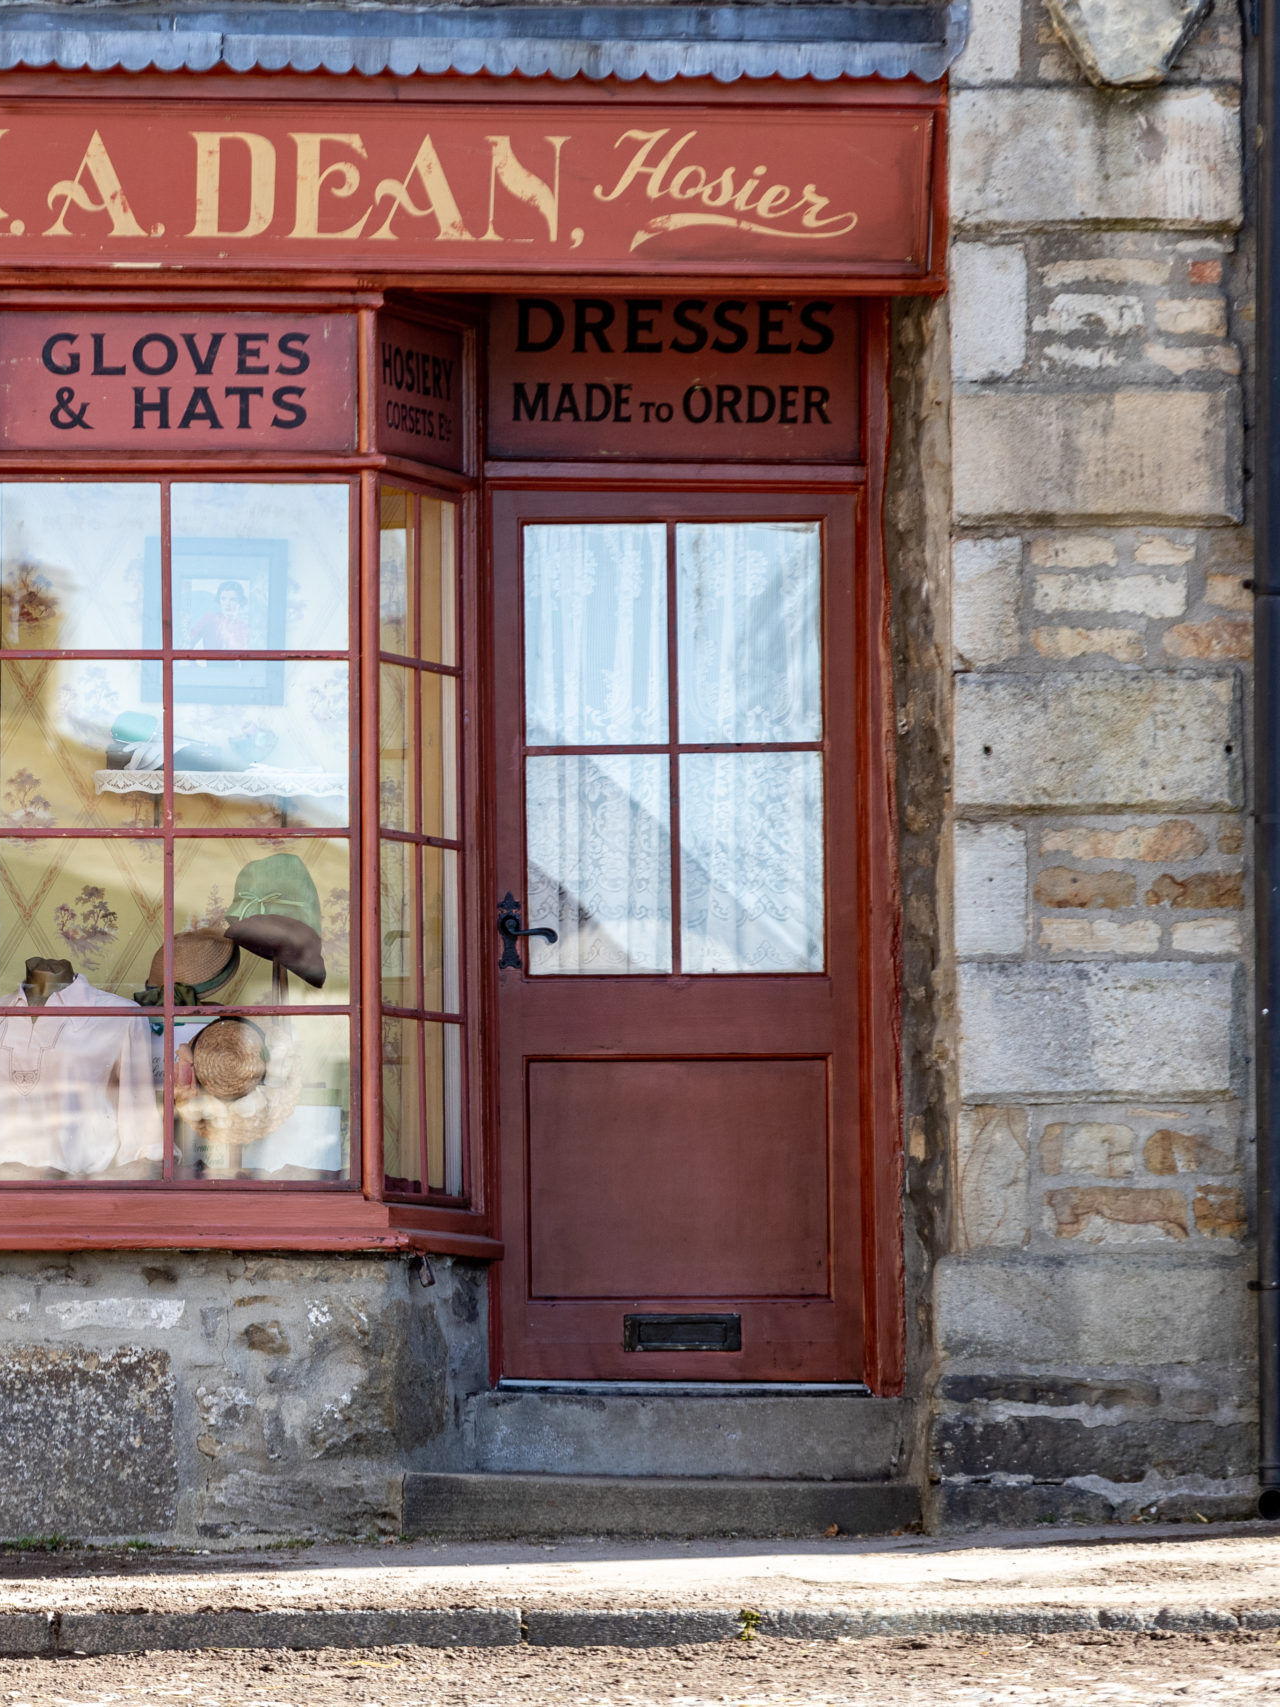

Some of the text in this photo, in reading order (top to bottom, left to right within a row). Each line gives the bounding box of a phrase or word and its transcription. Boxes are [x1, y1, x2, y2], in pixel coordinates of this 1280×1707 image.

[188, 130, 585, 249] DEAN,
[593, 128, 858, 252] Hosier
[514, 297, 836, 354] DRESSES
[41, 332, 311, 376] GLOVES
[381, 341, 454, 400] HOSIERY
[49, 385, 308, 429] & HATS
[511, 382, 831, 424] MADE TO ORDER
